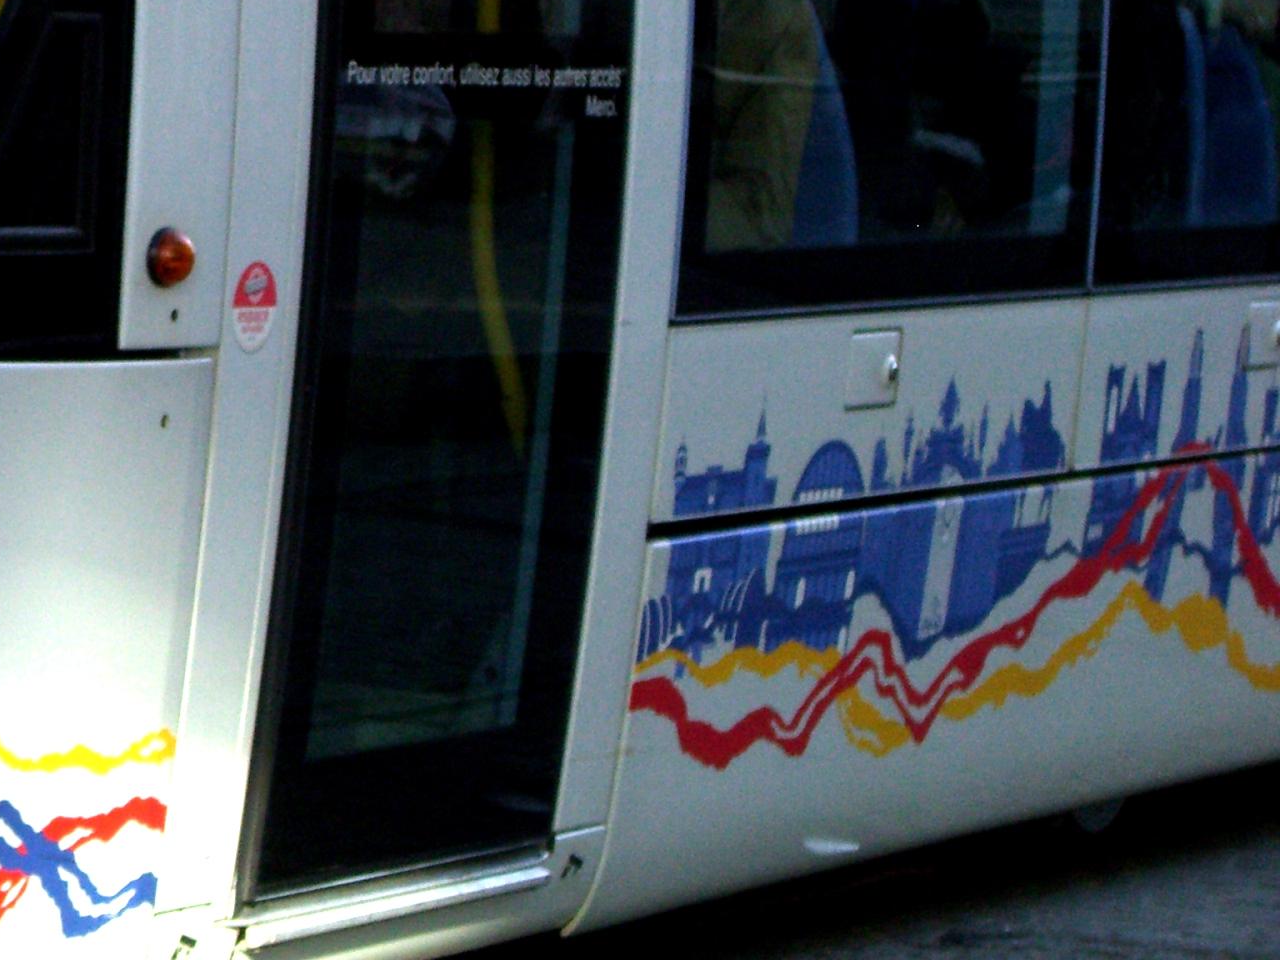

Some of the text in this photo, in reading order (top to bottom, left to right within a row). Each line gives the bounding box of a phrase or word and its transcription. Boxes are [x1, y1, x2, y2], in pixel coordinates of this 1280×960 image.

[347, 59, 378, 85] Pour
[380, 62, 411, 86] votre
[502, 66, 532, 88] aussi
[534, 64, 551, 88] les
